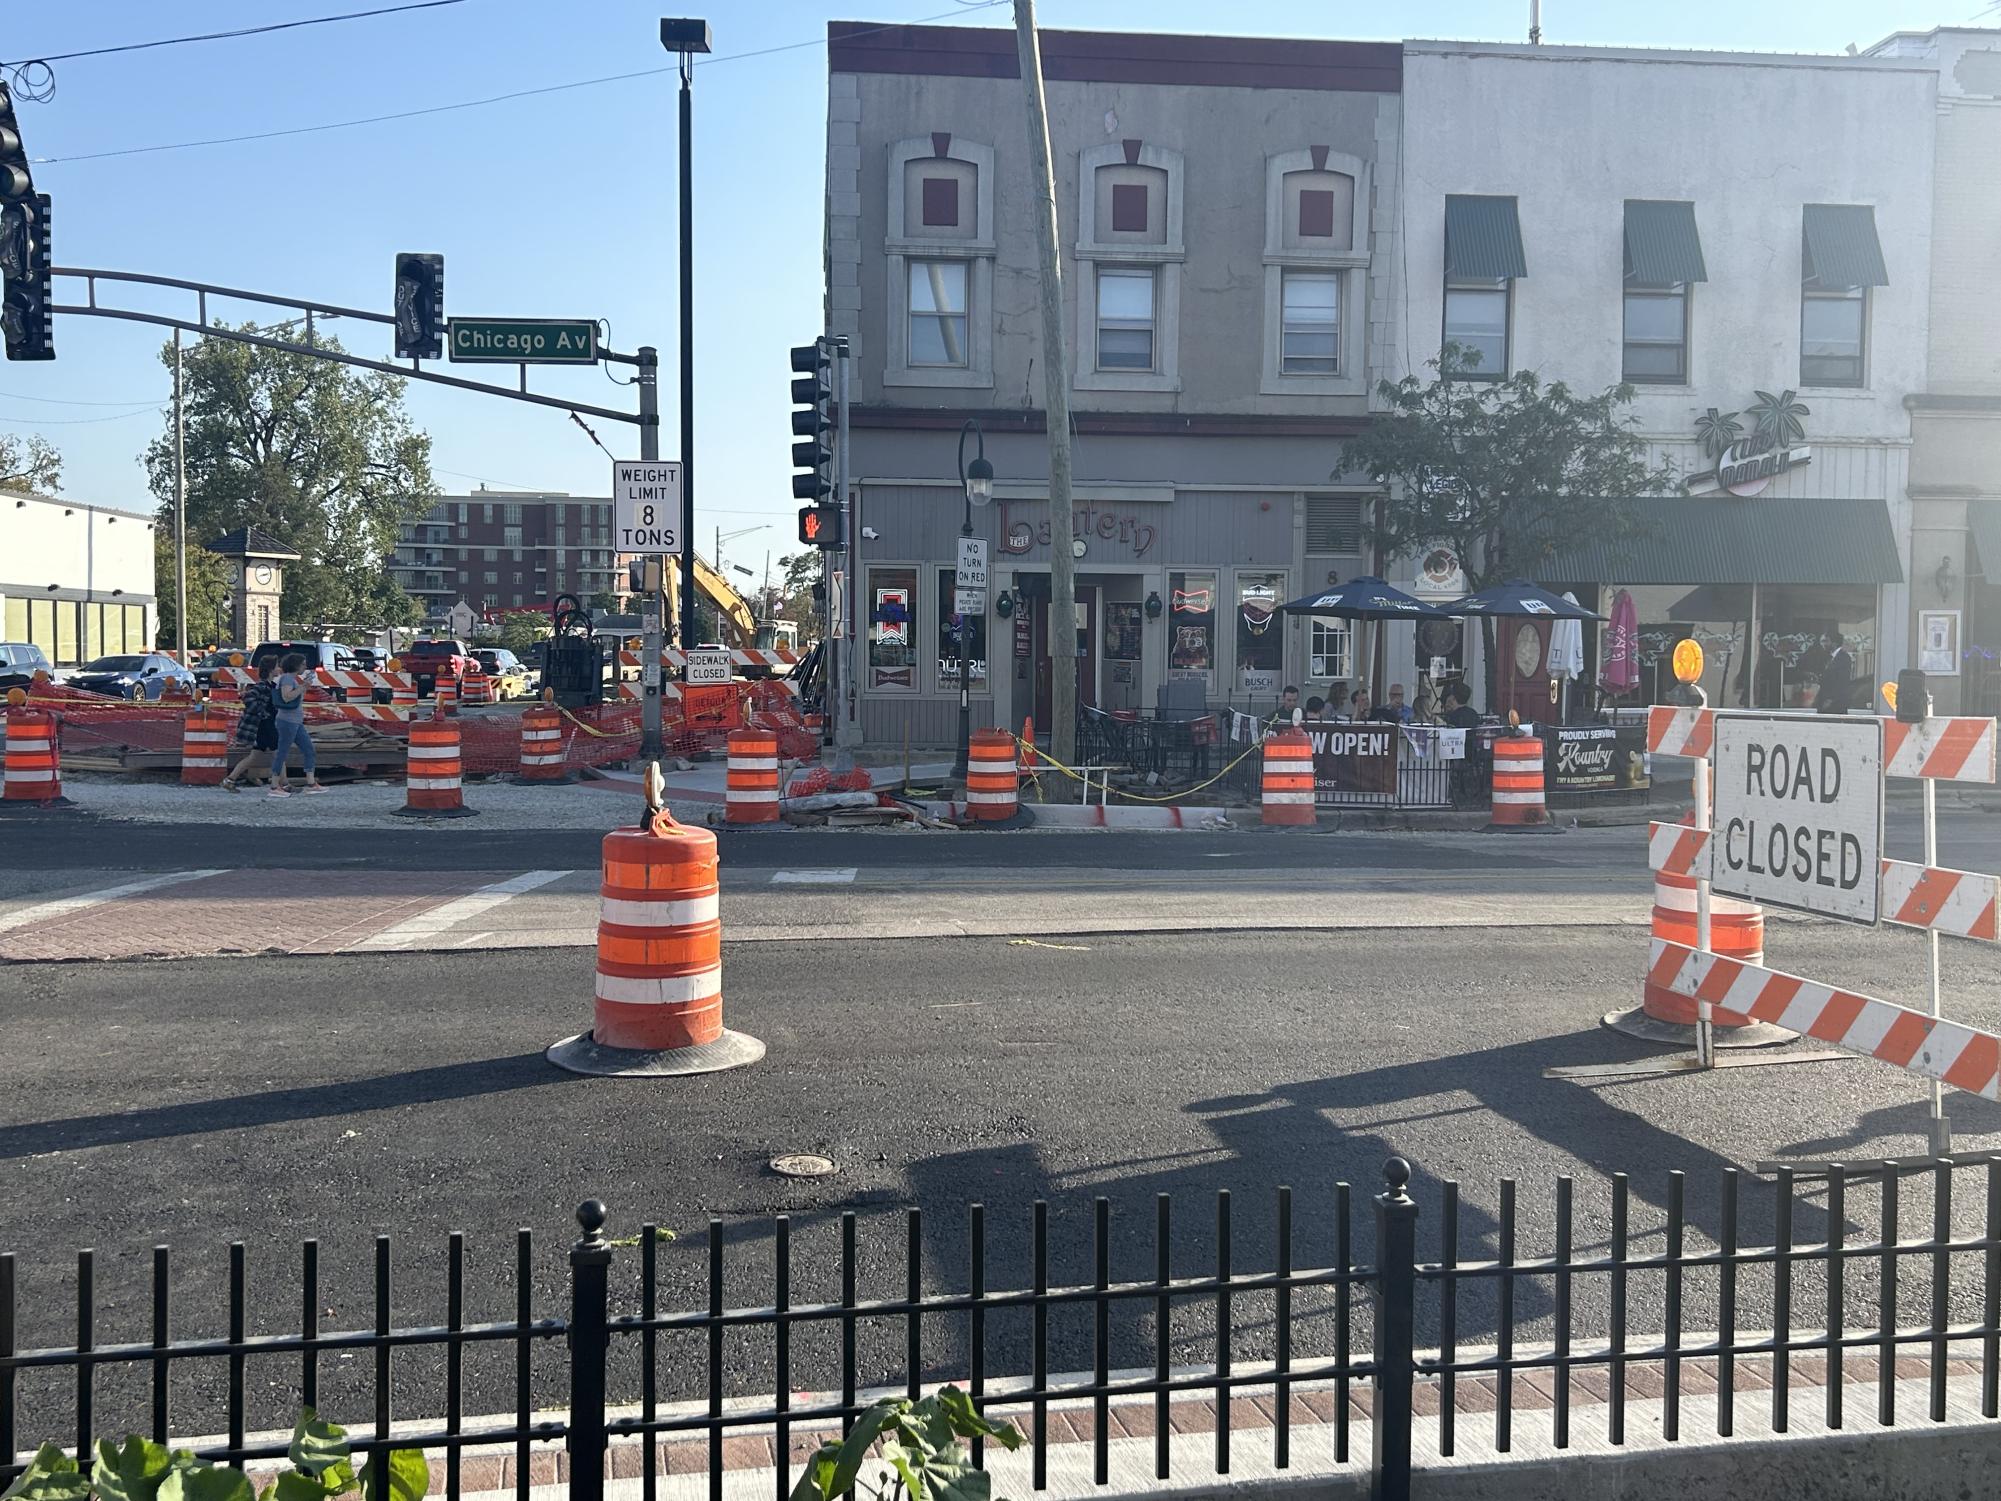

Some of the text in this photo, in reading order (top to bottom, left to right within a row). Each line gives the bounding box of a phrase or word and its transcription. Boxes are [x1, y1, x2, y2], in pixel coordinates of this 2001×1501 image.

[457, 329, 587, 354] Chicago Av
[621, 469, 677, 482] WEIGHT
[629, 487, 667, 500] LIMIT
[643, 505, 654, 526] 8
[622, 529, 675, 546] TONS
[1010, 535, 1029, 548] THE
[967, 543, 979, 554] NO
[963, 557, 982, 568] TURN
[959, 571, 985, 582] ON RED
[1327, 571, 1338, 585] 8
[688, 655, 730, 666] SIDEWALK
[693, 668, 725, 679] CLOSED
[1245, 678, 1273, 687] BUSCH
[1558, 729, 1616, 740] PROUDLY SERVING
[1331, 732, 1389, 756] OPEN!
[1557, 742, 1614, 773] Kountry
[1746, 743, 1841, 804] ROAD
[1725, 817, 1862, 890] CLOSED
